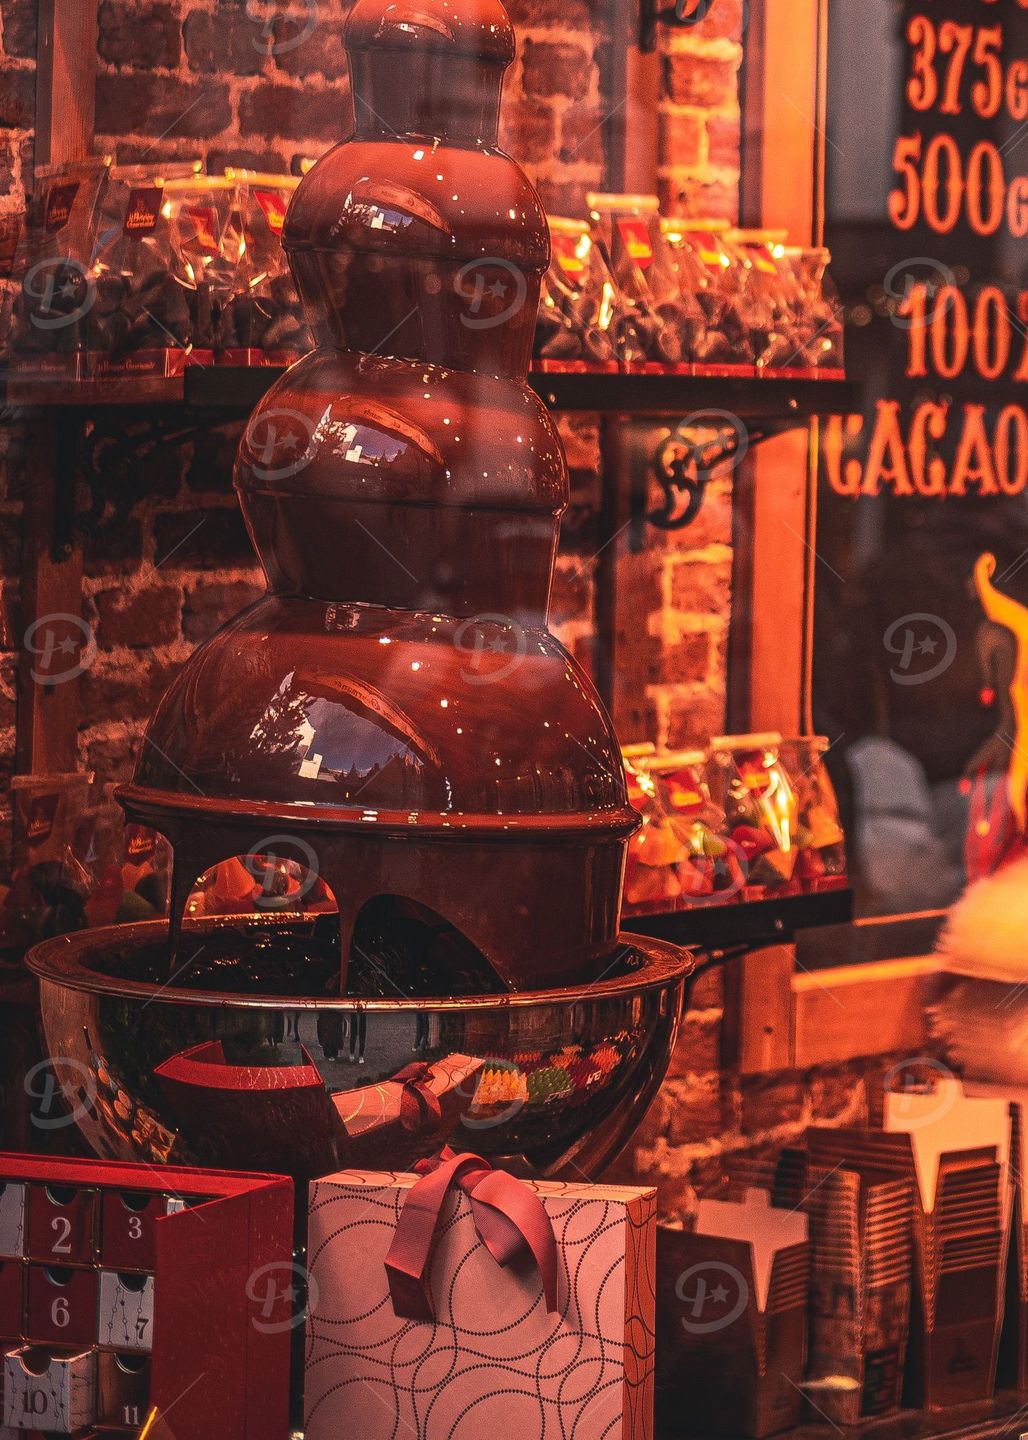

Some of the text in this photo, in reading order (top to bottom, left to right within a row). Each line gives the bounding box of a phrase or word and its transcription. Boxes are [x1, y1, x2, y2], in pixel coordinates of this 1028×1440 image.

[906, 16, 1002, 117] 375
[888, 131, 1004, 236] 500
[51, 1217, 72, 1254] 2
[127, 1216, 142, 1239] 3
[51, 1297, 70, 1328] 6
[136, 1318, 149, 1340] 7
[22, 1390, 48, 1415] 10
